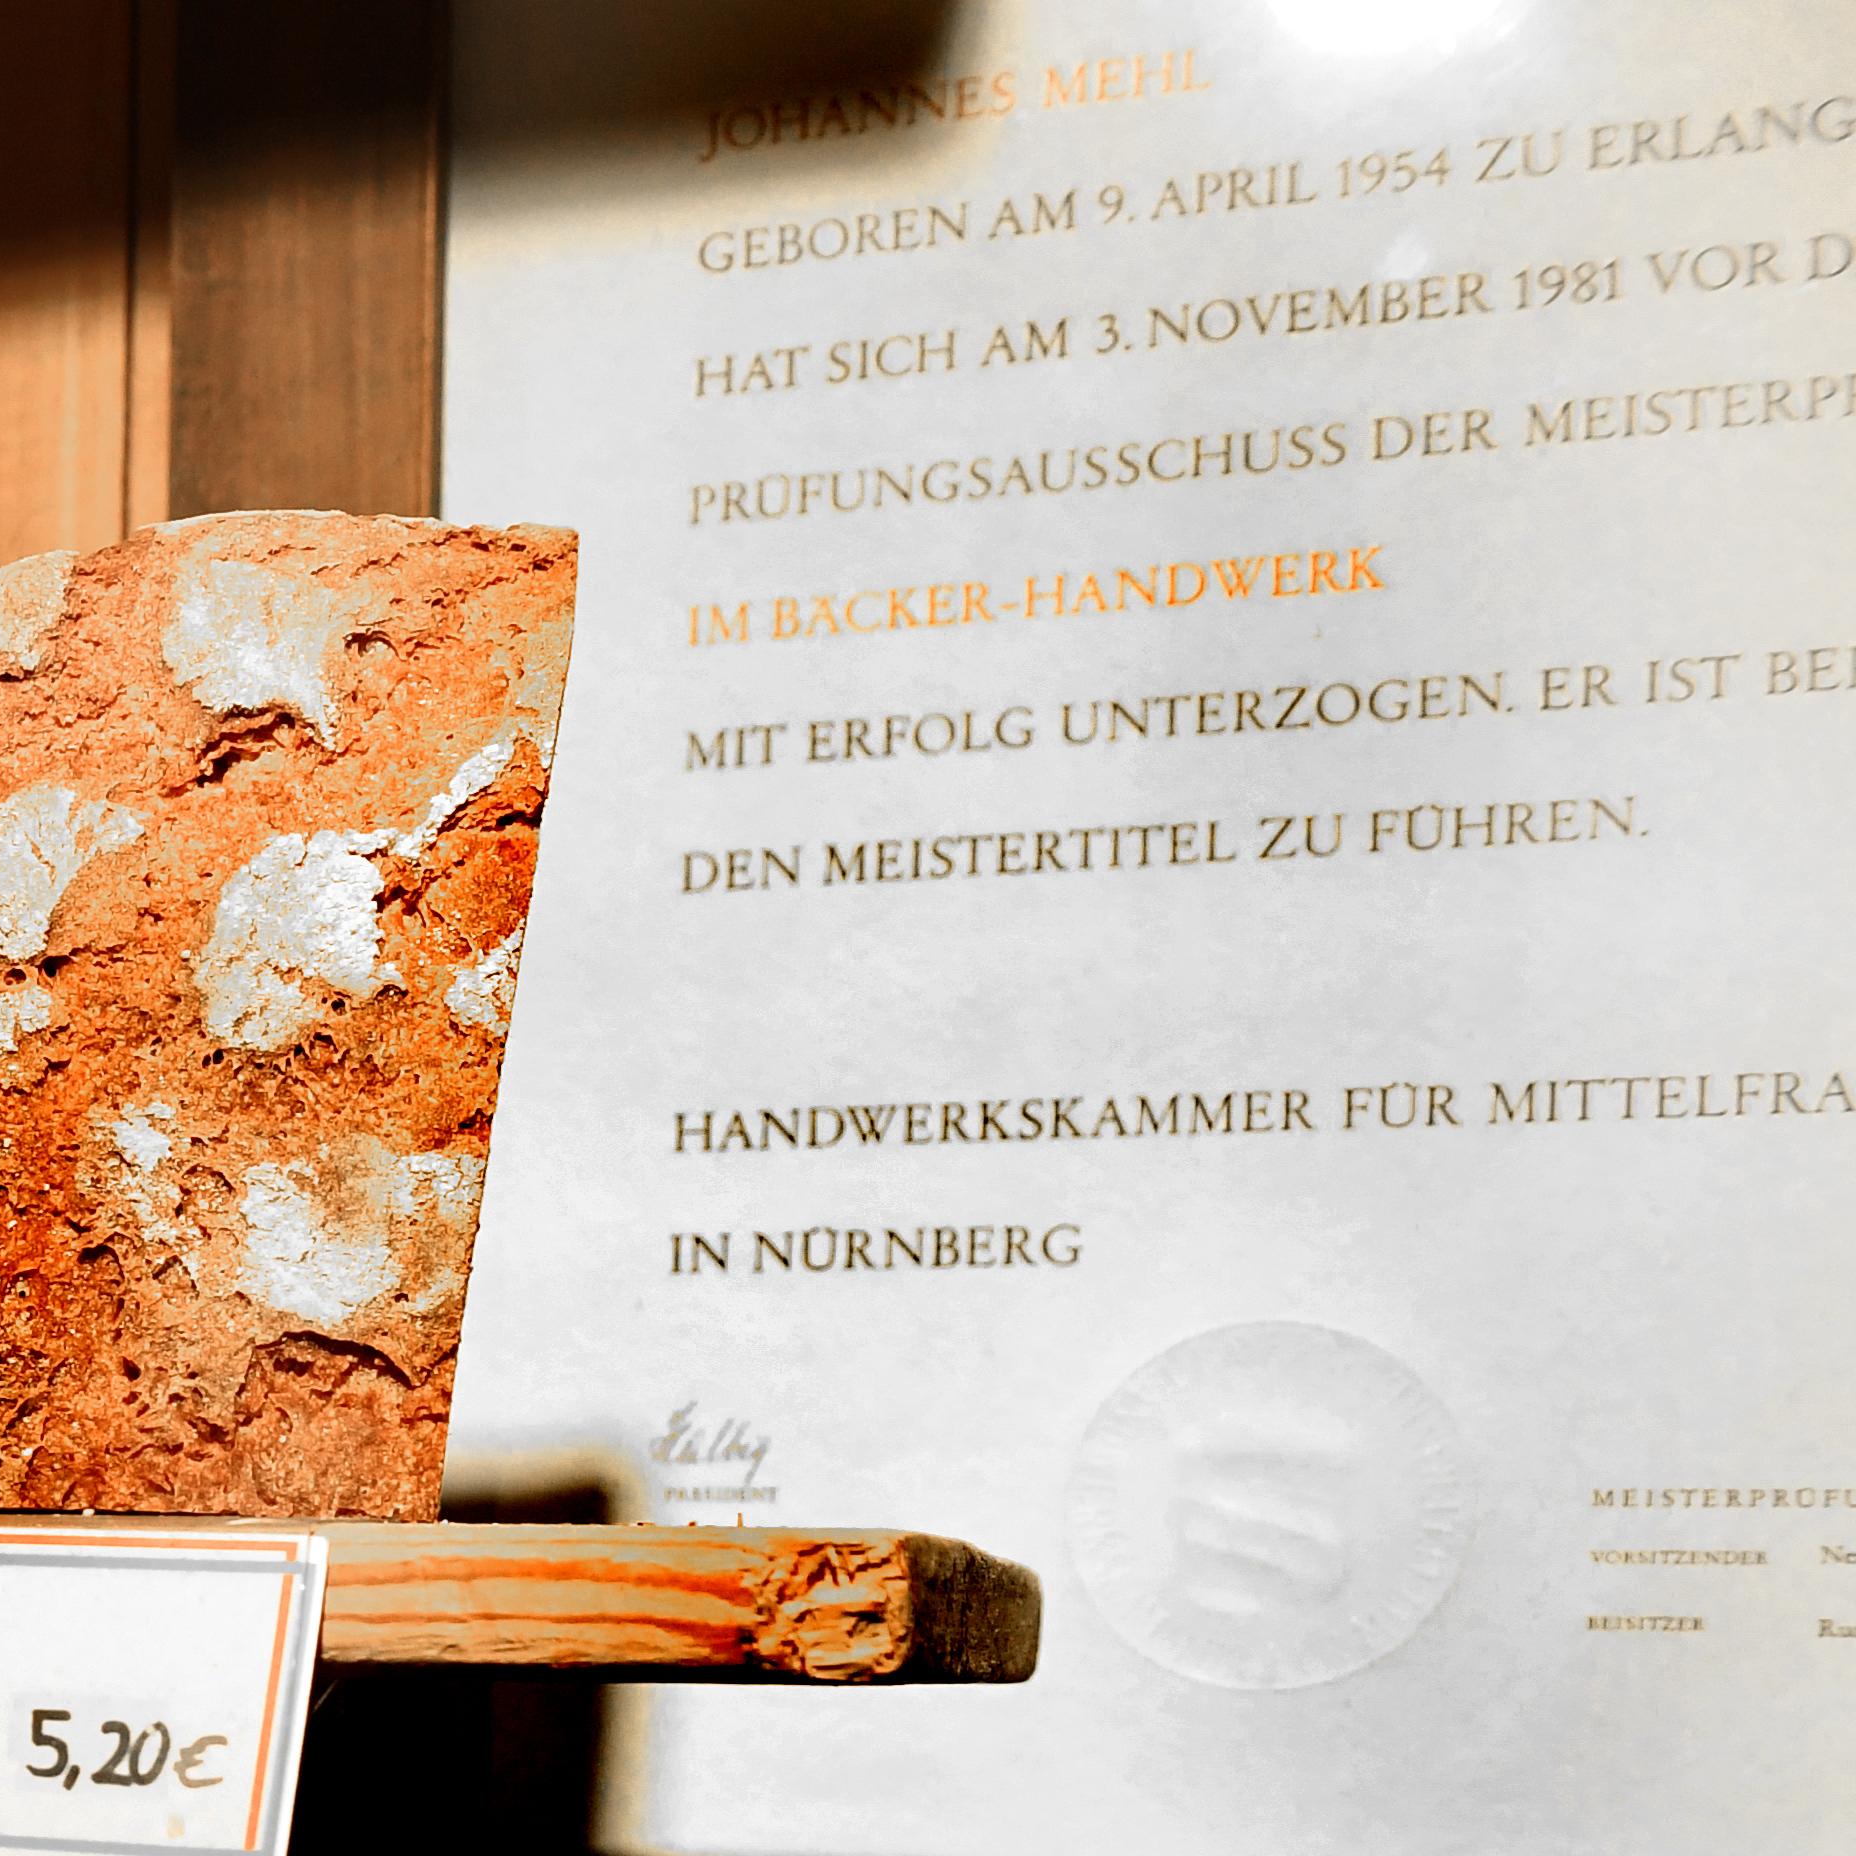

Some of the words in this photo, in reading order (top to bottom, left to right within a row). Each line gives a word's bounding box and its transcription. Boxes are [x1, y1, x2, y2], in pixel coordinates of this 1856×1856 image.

[698, 71, 1018, 163] JOHANNES
[1042, 47, 1213, 108] MEHL
[698, 202, 971, 274] GEBOREN
[987, 189, 1078, 240] AM
[1098, 185, 1136, 224] 9.
[1150, 160, 1317, 220] APRIL
[1337, 146, 1451, 200] 1954
[1476, 128, 1566, 184] ZU
[693, 344, 810, 398] HAT
[826, 329, 957, 385] SICH
[980, 317, 1070, 369] AM
[1095, 314, 1132, 355] 3.
[1147, 271, 1493, 348] NOVEMBER
[1514, 257, 1622, 310] 1981
[1645, 240, 1787, 294] VOR
[688, 421, 1348, 527] PRÜFUNGSAUSSCHUSS
[1371, 408, 1498, 462] DER
[688, 602, 750, 647] IM
[685, 723, 787, 772] MIT
[806, 705, 1035, 765] ERFOLG
[1061, 668, 1515, 747] UNTERZOGEN.
[1539, 664, 1619, 712] ER
[1645, 651, 1743, 704] IST
[681, 845, 801, 894] DEN
[821, 820, 1237, 887] MEISTERTITEL
[1257, 812, 1345, 861] ZU
[1368, 795, 1650, 855] FÜHREN.
[674, 1089, 1316, 1152] HANDWERKSKAMMER
[1342, 1081, 1463, 1131] FÜR
[1488, 1070, 1856, 1126] MITTELFRA
[669, 1231, 730, 1275] IN
[752, 1223, 1084, 1274] NÜRNBERG
[26, 1709, 228, 1791] 5,20€
